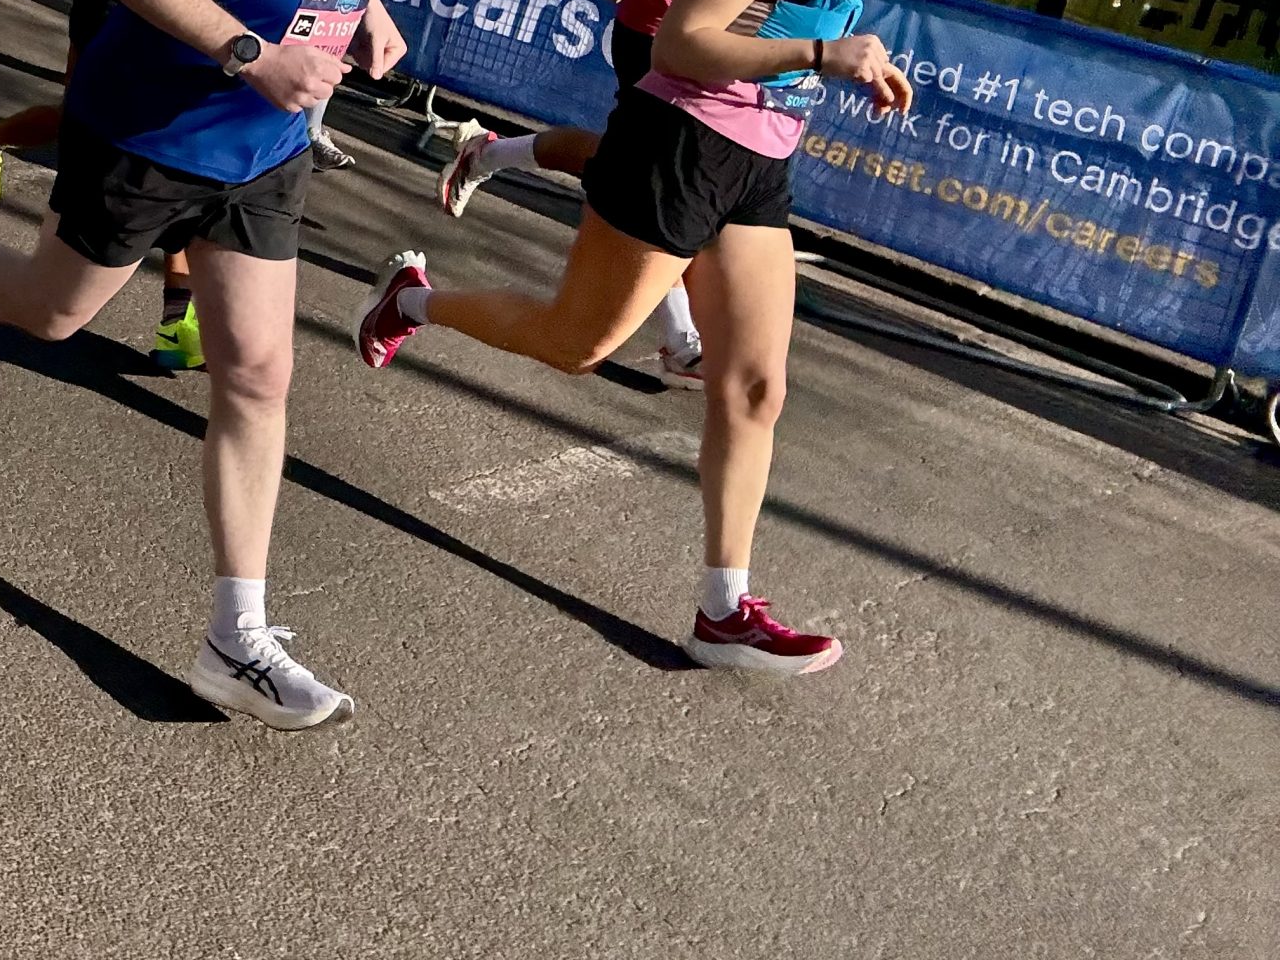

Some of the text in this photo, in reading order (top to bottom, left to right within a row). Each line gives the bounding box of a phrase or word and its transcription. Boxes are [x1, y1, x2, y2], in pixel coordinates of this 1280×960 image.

[972, 70, 1021, 111] #1
[1033, 88, 1127, 142] tech
[933, 112, 991, 156] for
[1000, 132, 1036, 173] in
[804, 132, 1220, 290] earset.com/careers
